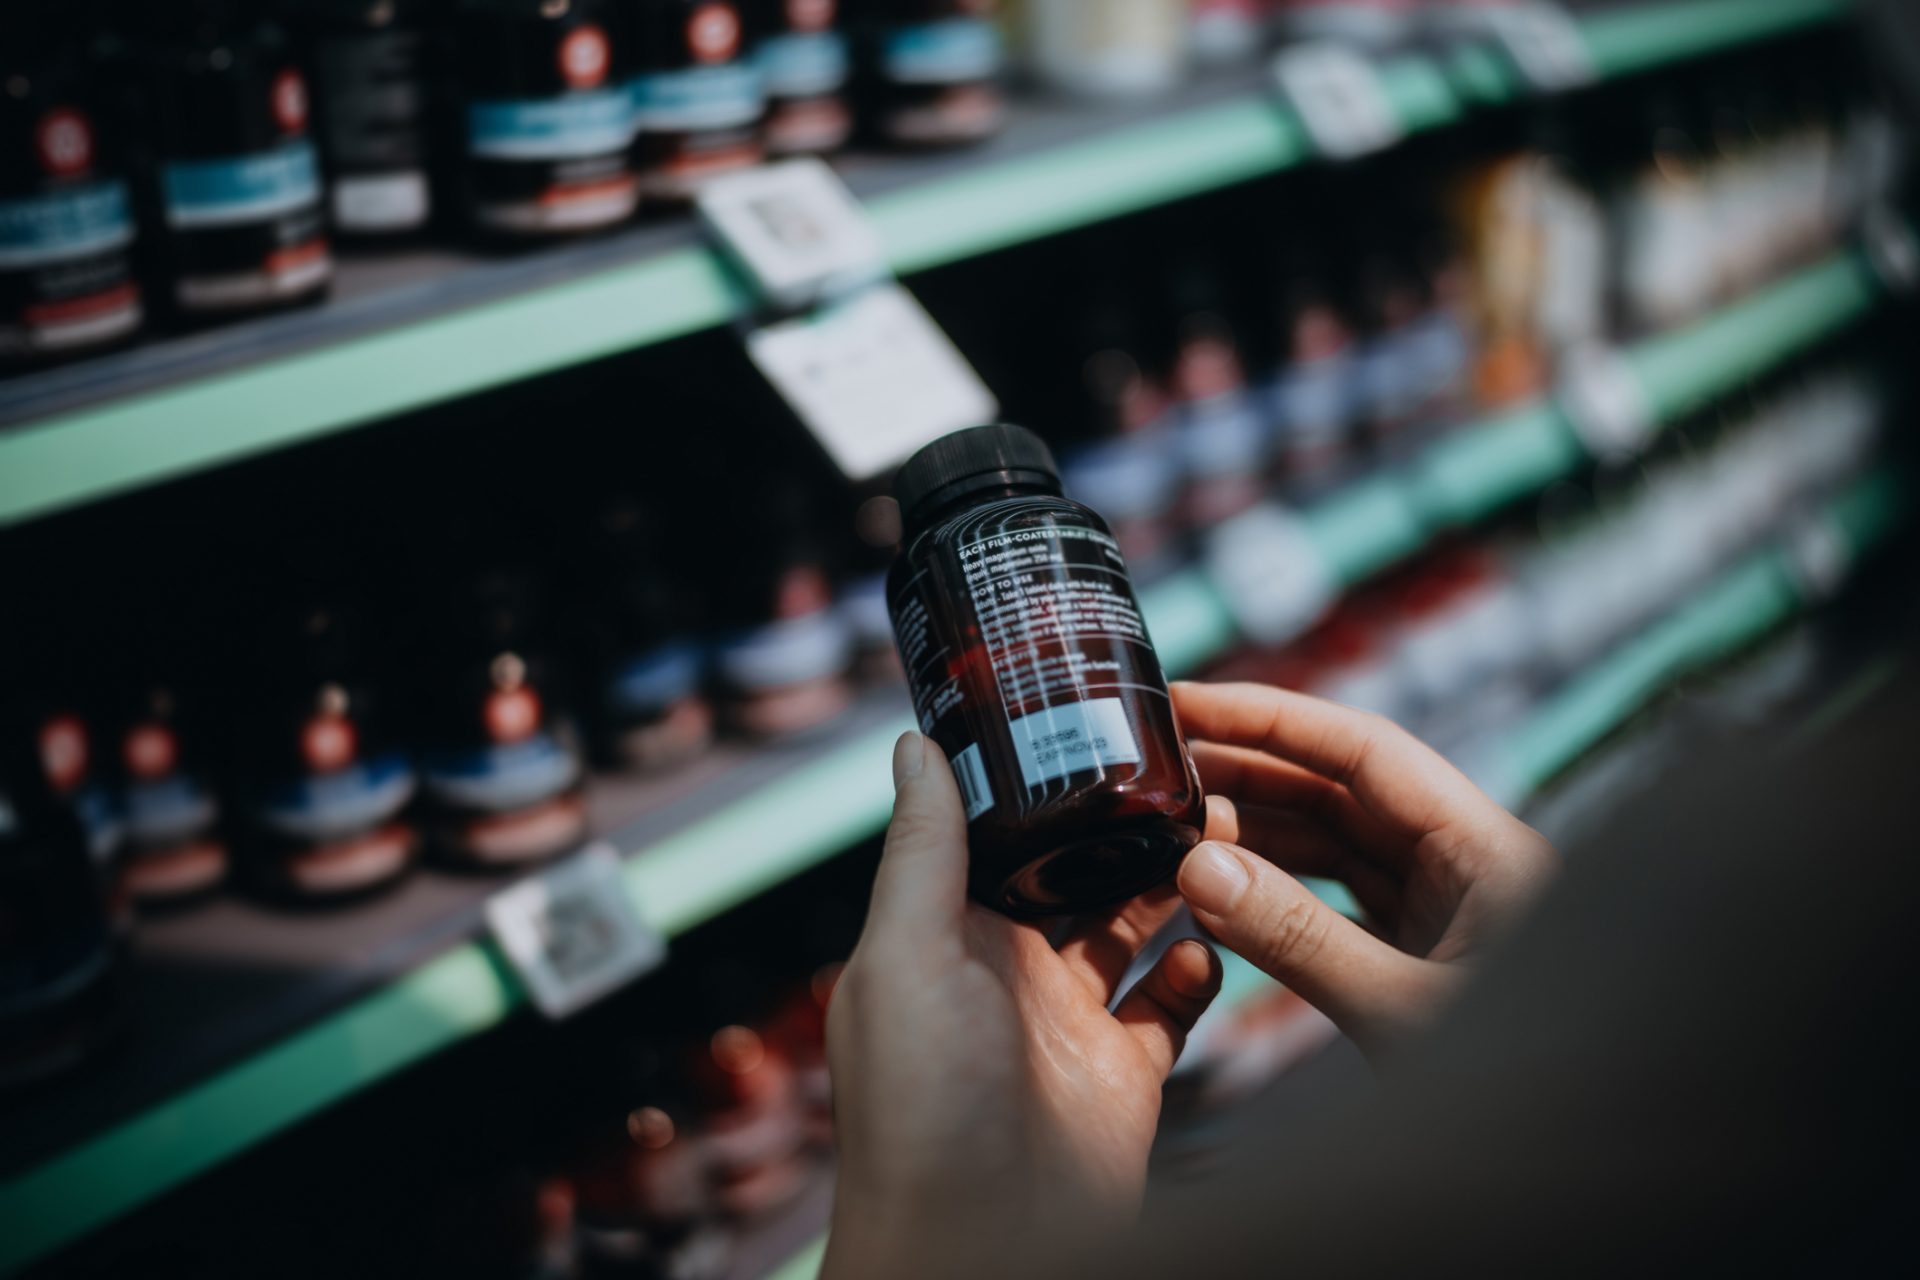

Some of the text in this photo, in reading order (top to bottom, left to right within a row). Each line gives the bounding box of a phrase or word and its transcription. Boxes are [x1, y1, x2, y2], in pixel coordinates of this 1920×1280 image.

[959, 543, 987, 560] EACH
[988, 530, 1055, 550] FILM-COATED
[962, 559, 985, 573] Heavy
[972, 574, 1033, 600] HOW TO USE
[1001, 590, 1020, 602] Take
